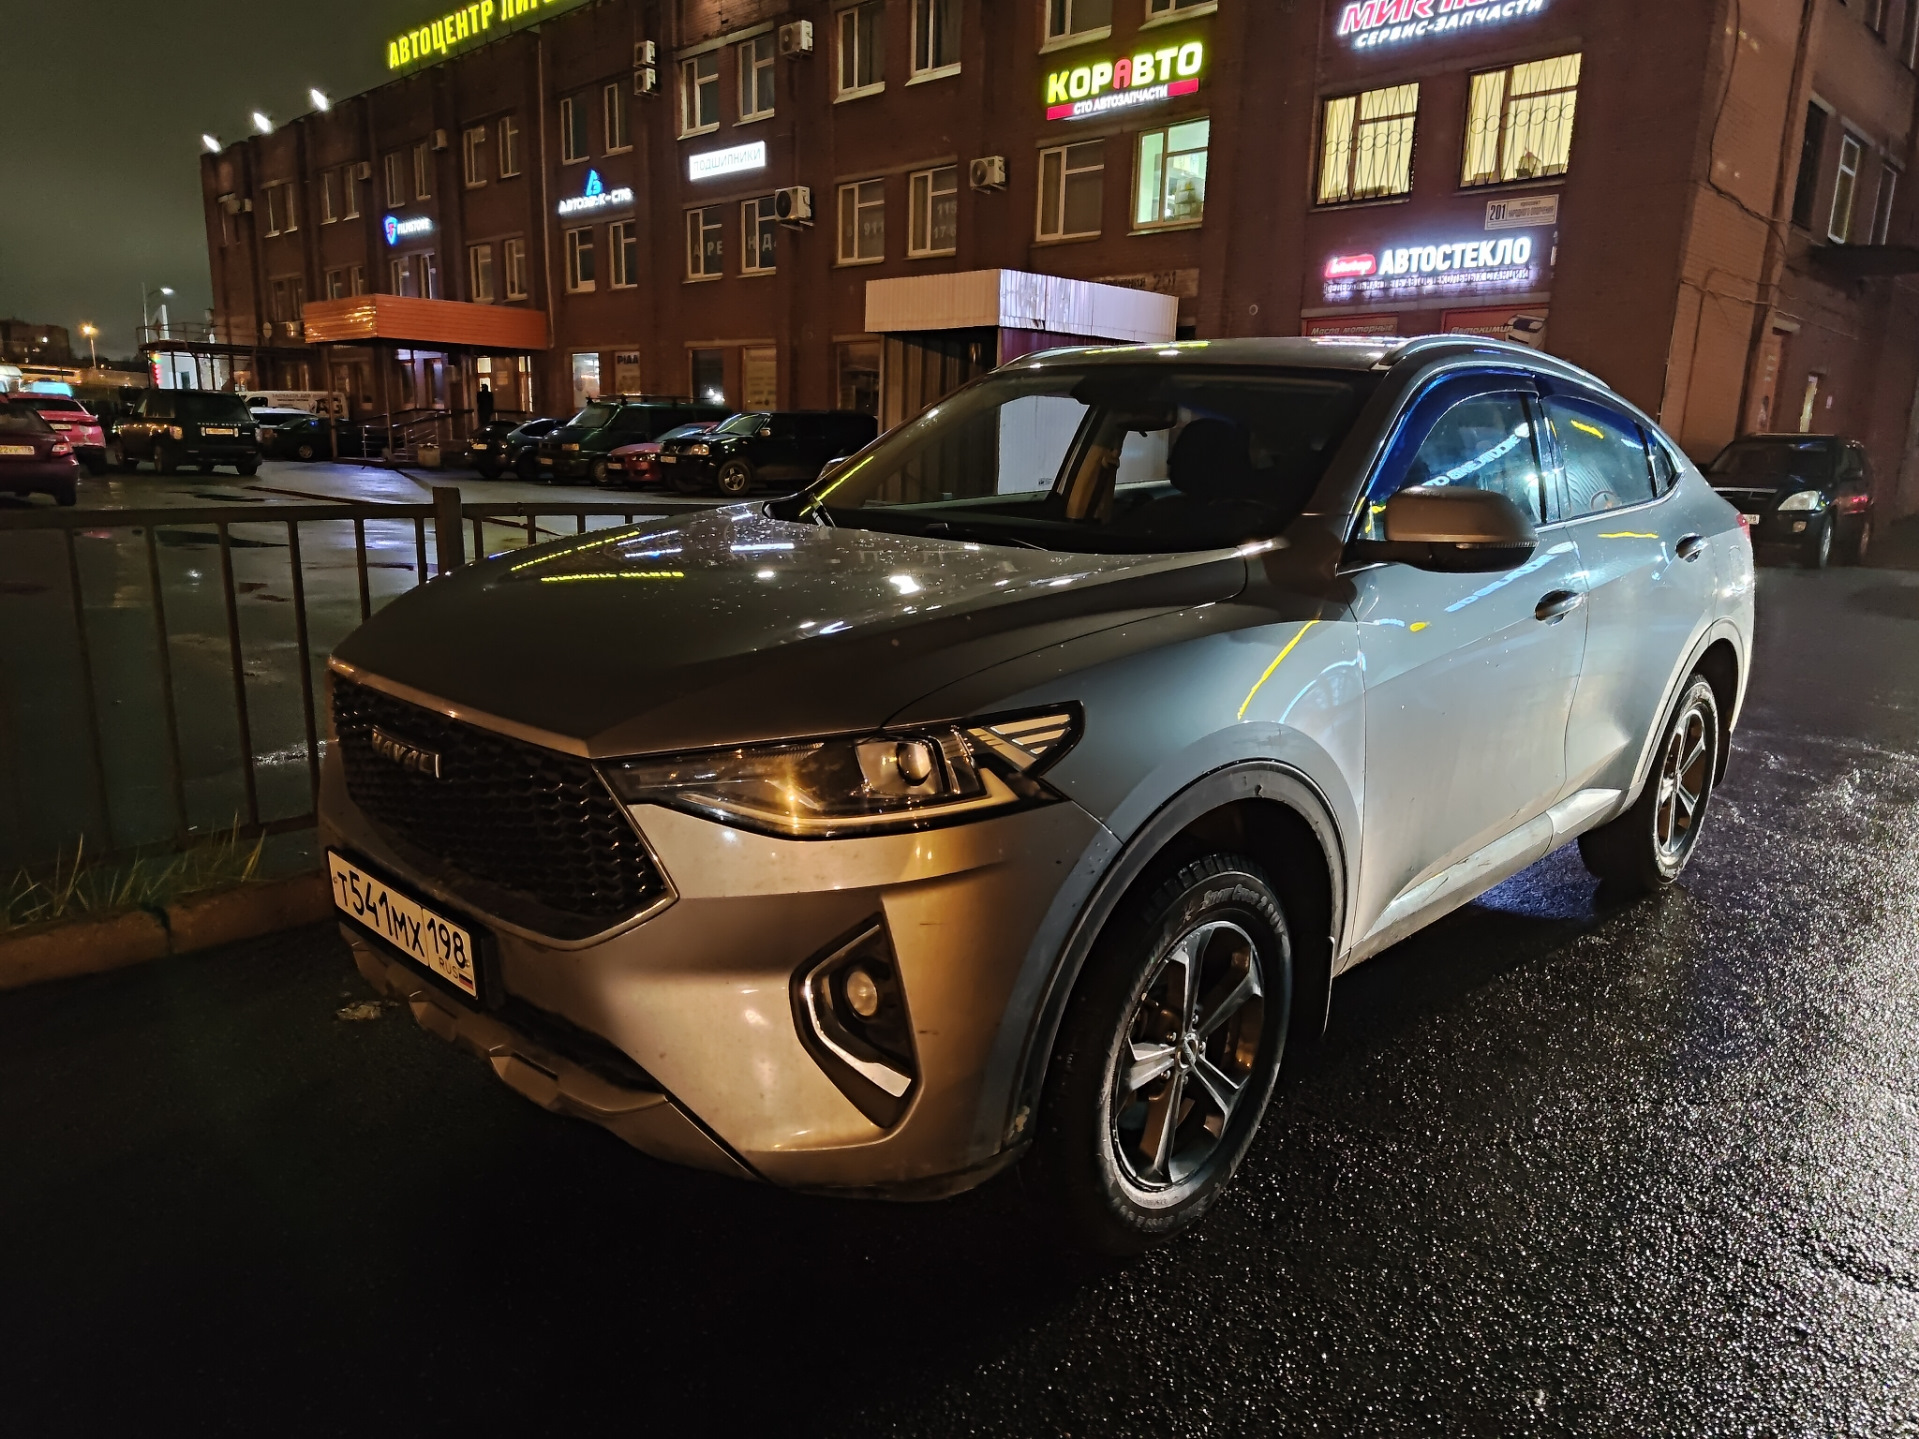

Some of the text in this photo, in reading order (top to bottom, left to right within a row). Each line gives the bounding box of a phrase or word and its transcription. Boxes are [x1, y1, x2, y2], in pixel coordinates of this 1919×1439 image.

[389, 0, 493, 69] АВТОЦЕНТР
[1355, 0, 1544, 48] СЕРВИС-ЗАПЧАСТИ
[1047, 42, 1203, 104] КОРАВТО
[1073, 84, 1168, 116] СТО АВТОЗАПЧАСТИ
[693, 148, 761, 173] ПОДШИПНИКИ
[1490, 204, 1506, 221] 201
[1379, 236, 1532, 275] АВТОСТЕКЛО
[1310, 324, 1394, 336] Масла моторные
[617, 354, 639, 365] PIAA
[337, 870, 466, 969] Т541МХ 198
[438, 956, 459, 979] RUS
